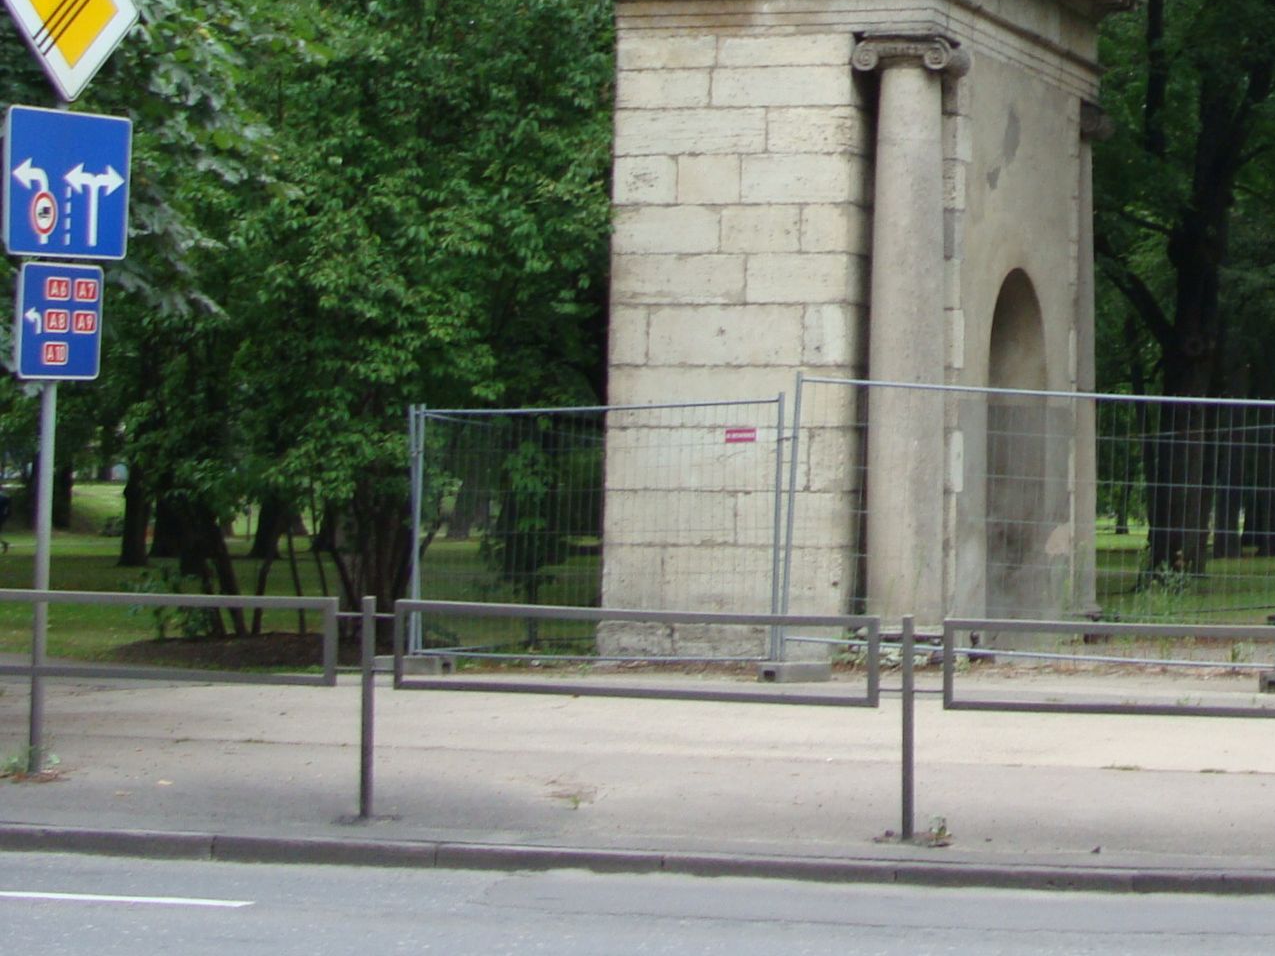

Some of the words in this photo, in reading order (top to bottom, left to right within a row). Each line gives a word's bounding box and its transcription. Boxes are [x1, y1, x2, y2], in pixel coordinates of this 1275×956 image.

[50, 280, 67, 297] A6
[79, 283, 95, 299] A7
[49, 313, 66, 329] A8
[77, 314, 94, 330] A9
[46, 345, 66, 361] A10
